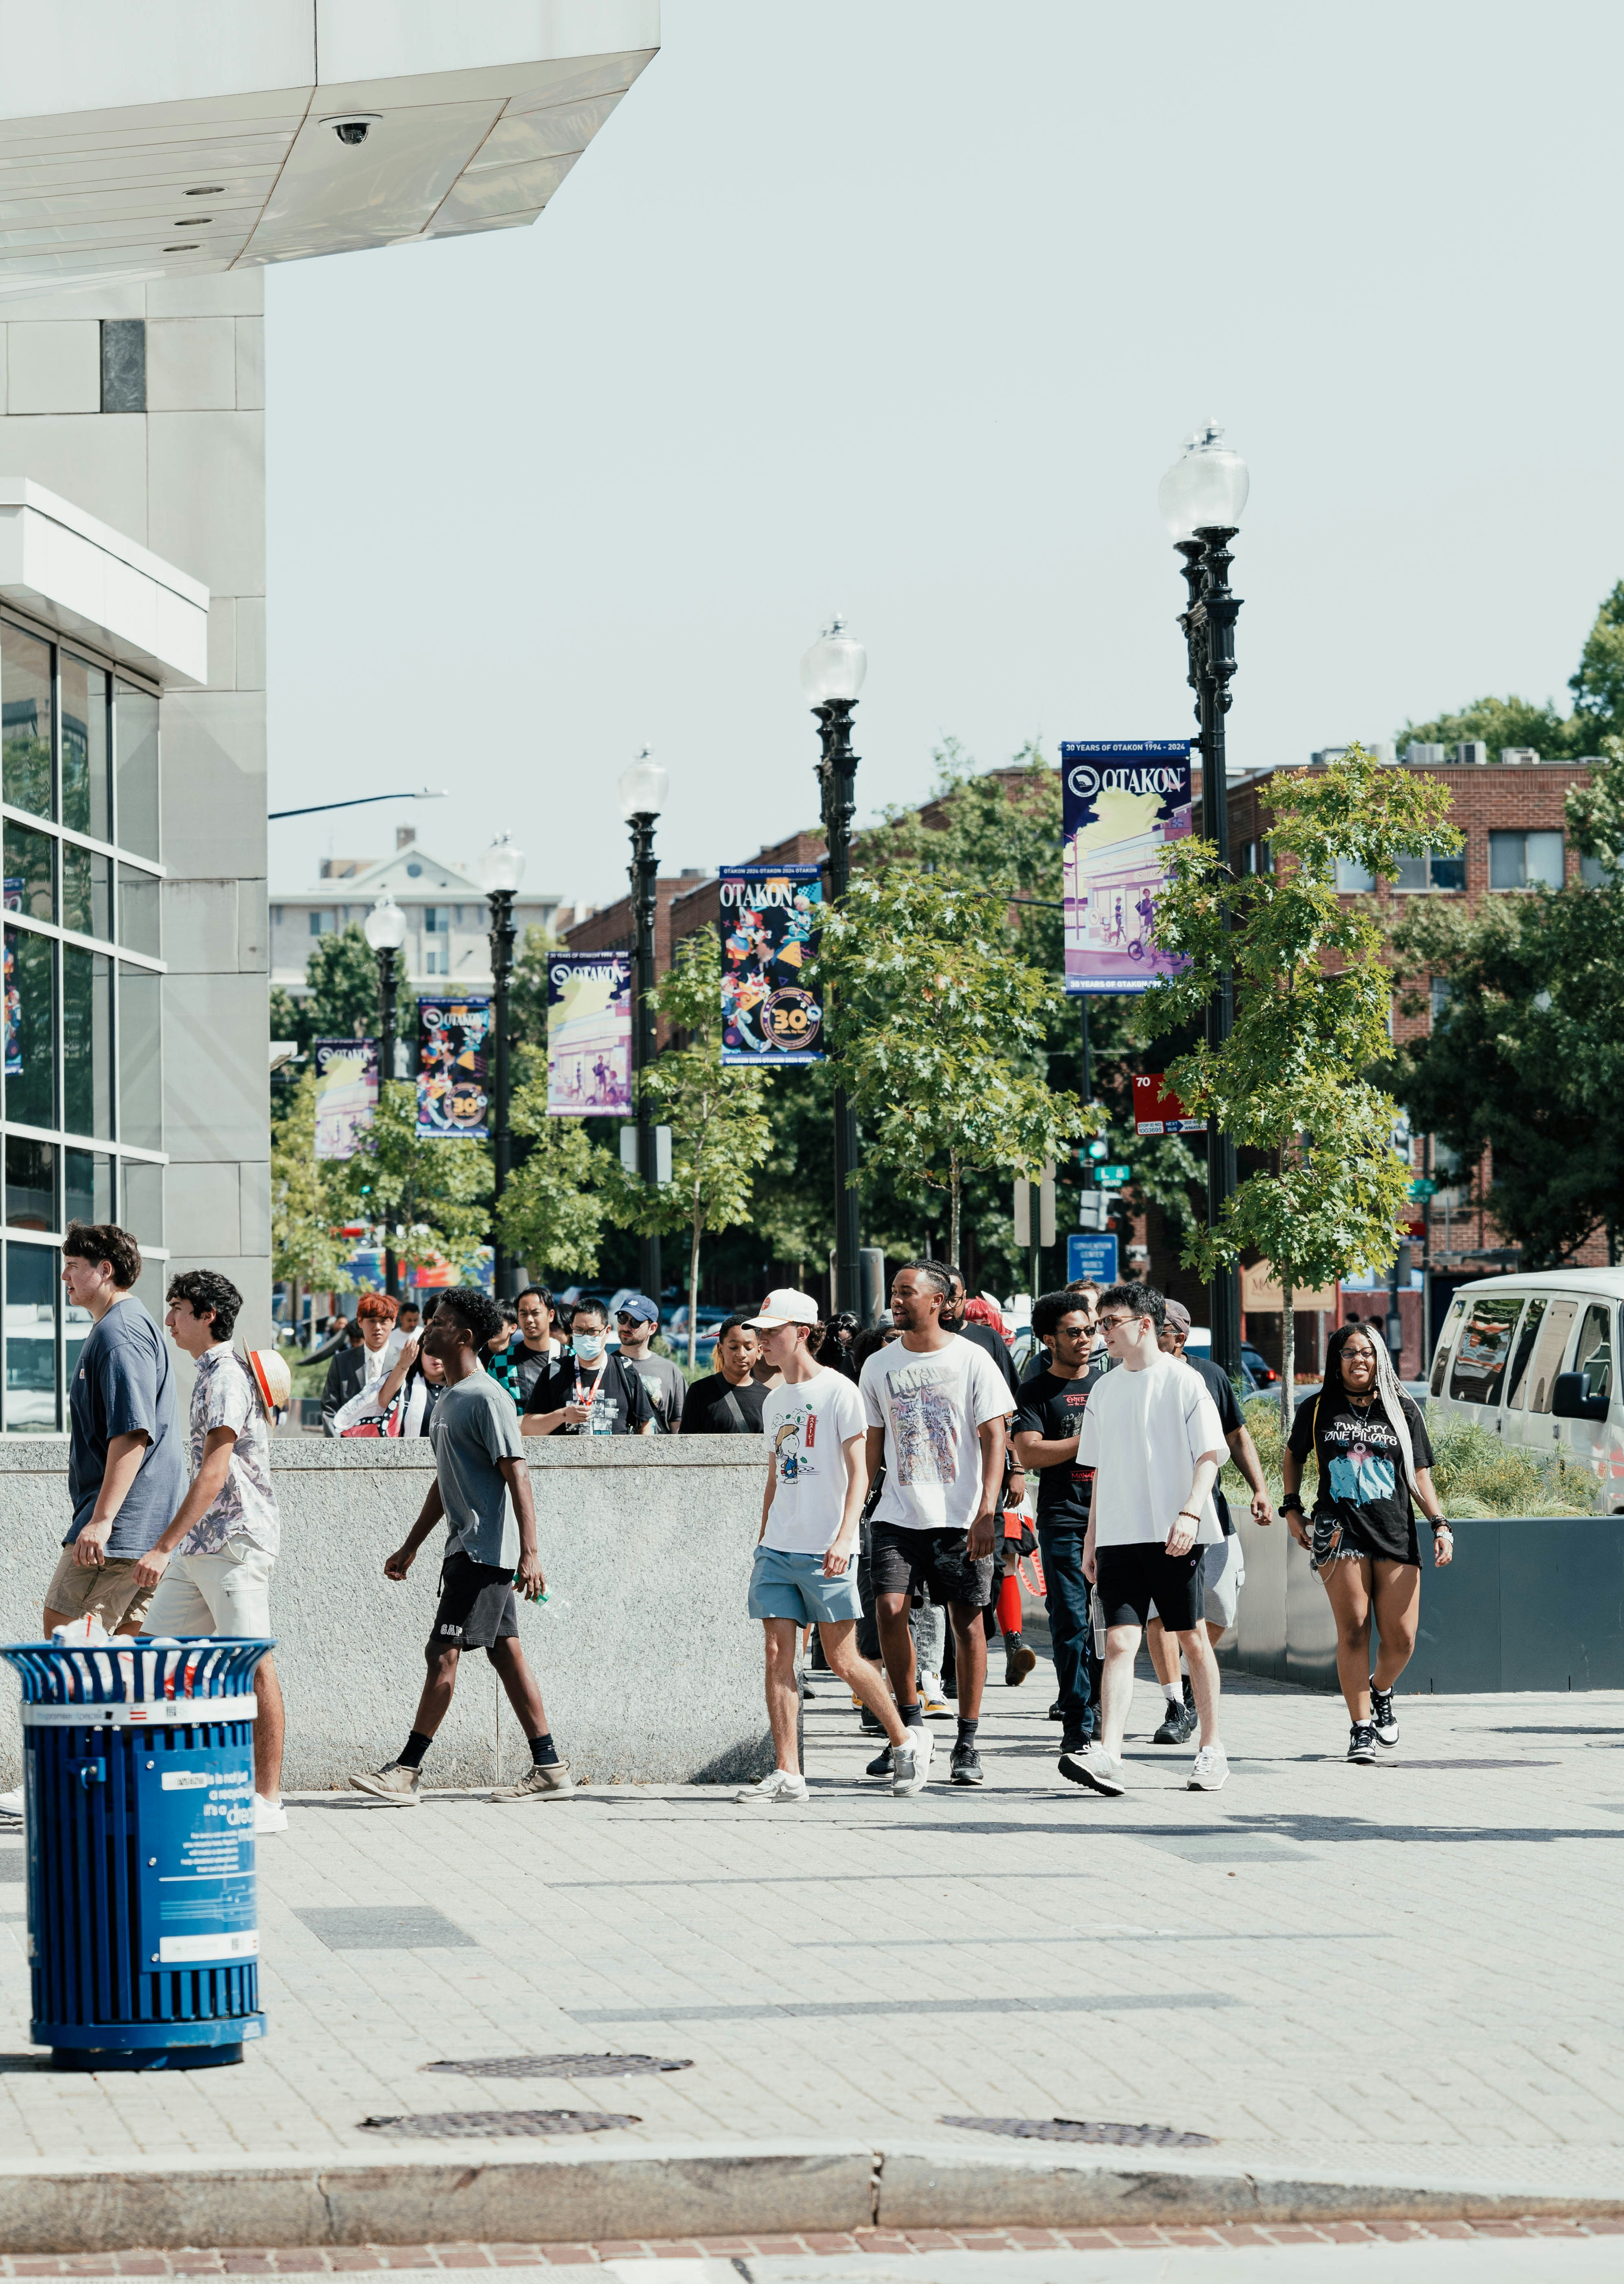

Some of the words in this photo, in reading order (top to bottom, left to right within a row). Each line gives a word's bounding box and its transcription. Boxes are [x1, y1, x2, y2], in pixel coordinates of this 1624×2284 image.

[1102, 768, 1182, 794] OTAKON
[720, 883, 794, 907] OTAKON
[572, 965, 624, 983] OTAKON
[444, 1013, 483, 1027] OTAKON
[774, 1009, 807, 1029] 30
[1136, 1077, 1151, 1087] 70
[453, 1097, 477, 1113] 30
[1073, 1242, 1112, 1250] CONVENTION
[1334, 1422, 1387, 1434] TWENTY
[441, 1624, 463, 1637] GAP
[209, 1790, 218, 1801] a
[218, 1805, 227, 1816] a
